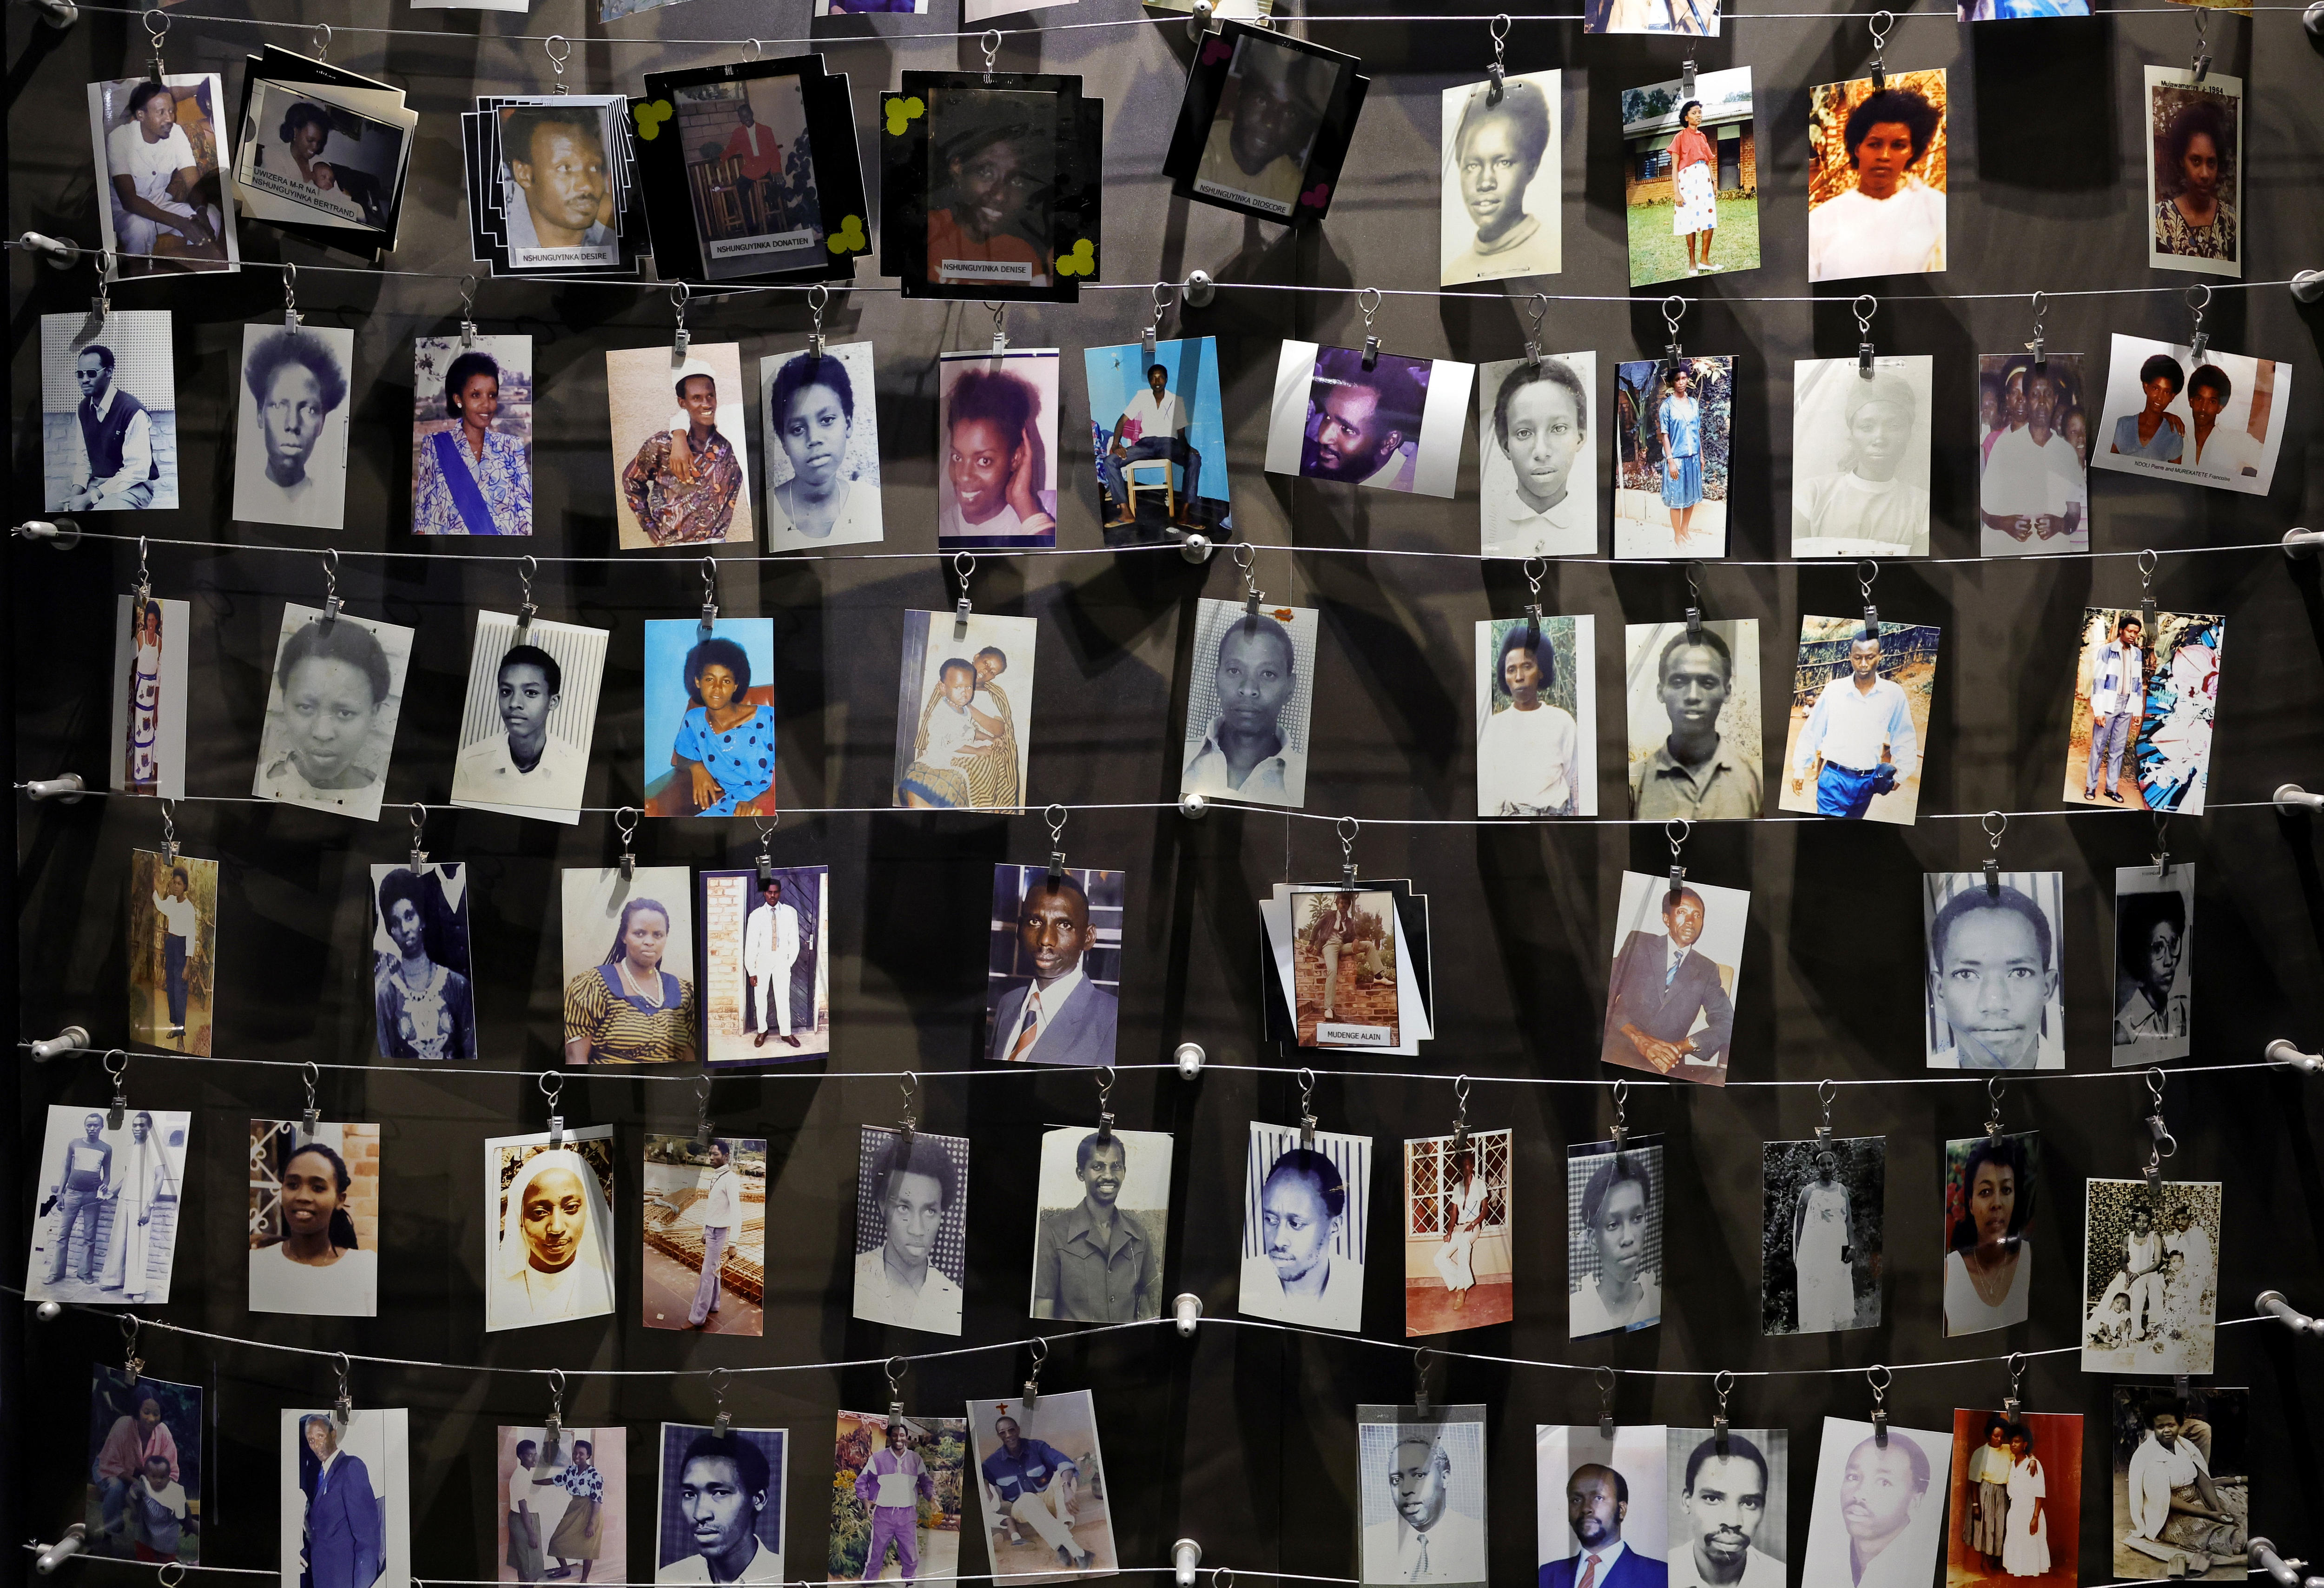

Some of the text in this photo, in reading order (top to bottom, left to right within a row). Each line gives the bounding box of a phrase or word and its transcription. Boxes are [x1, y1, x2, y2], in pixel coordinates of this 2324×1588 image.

[2209, 86, 2223, 94] 1964
[254, 168, 316, 195] UWIZERA M-R NA
[252, 177, 354, 218] NSHUNGUYINKA BERTRAND
[1200, 185, 1286, 213] NSHUNGUYINKA DIOSCORE
[717, 238, 808, 253] NSHUNGUYINKA DONATIEN
[944, 264, 999, 272] NSHUNGUYINKA
[2174, 468, 2208, 478] MUREKATETE
